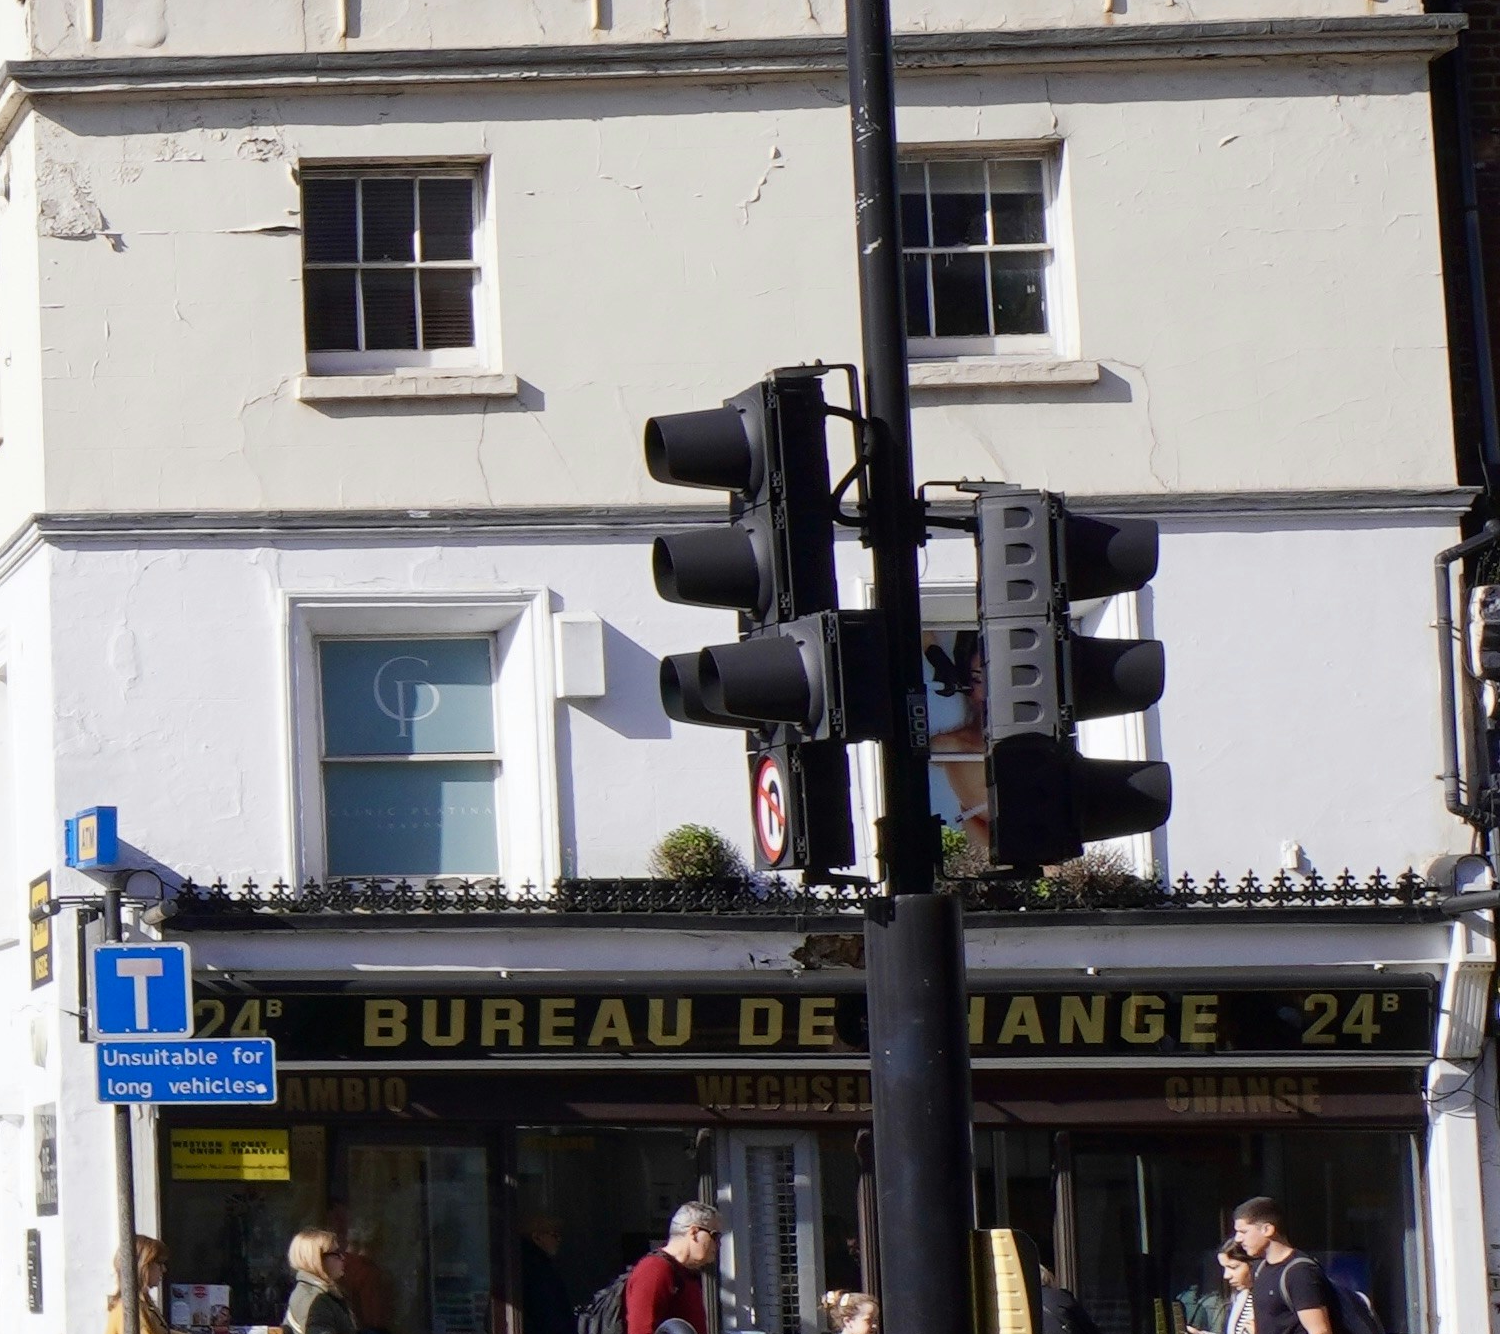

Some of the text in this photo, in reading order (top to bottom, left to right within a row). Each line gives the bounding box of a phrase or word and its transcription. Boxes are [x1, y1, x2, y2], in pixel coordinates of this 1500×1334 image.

[363, 997, 693, 1047] BUREAU
[738, 997, 837, 1046] DE
[103, 1047, 264, 1066] Unsuitable for
[107, 1077, 256, 1098] long vehicles
[284, 1077, 409, 1112] AMBIO
[1165, 1076, 1323, 1116] CHANGE
